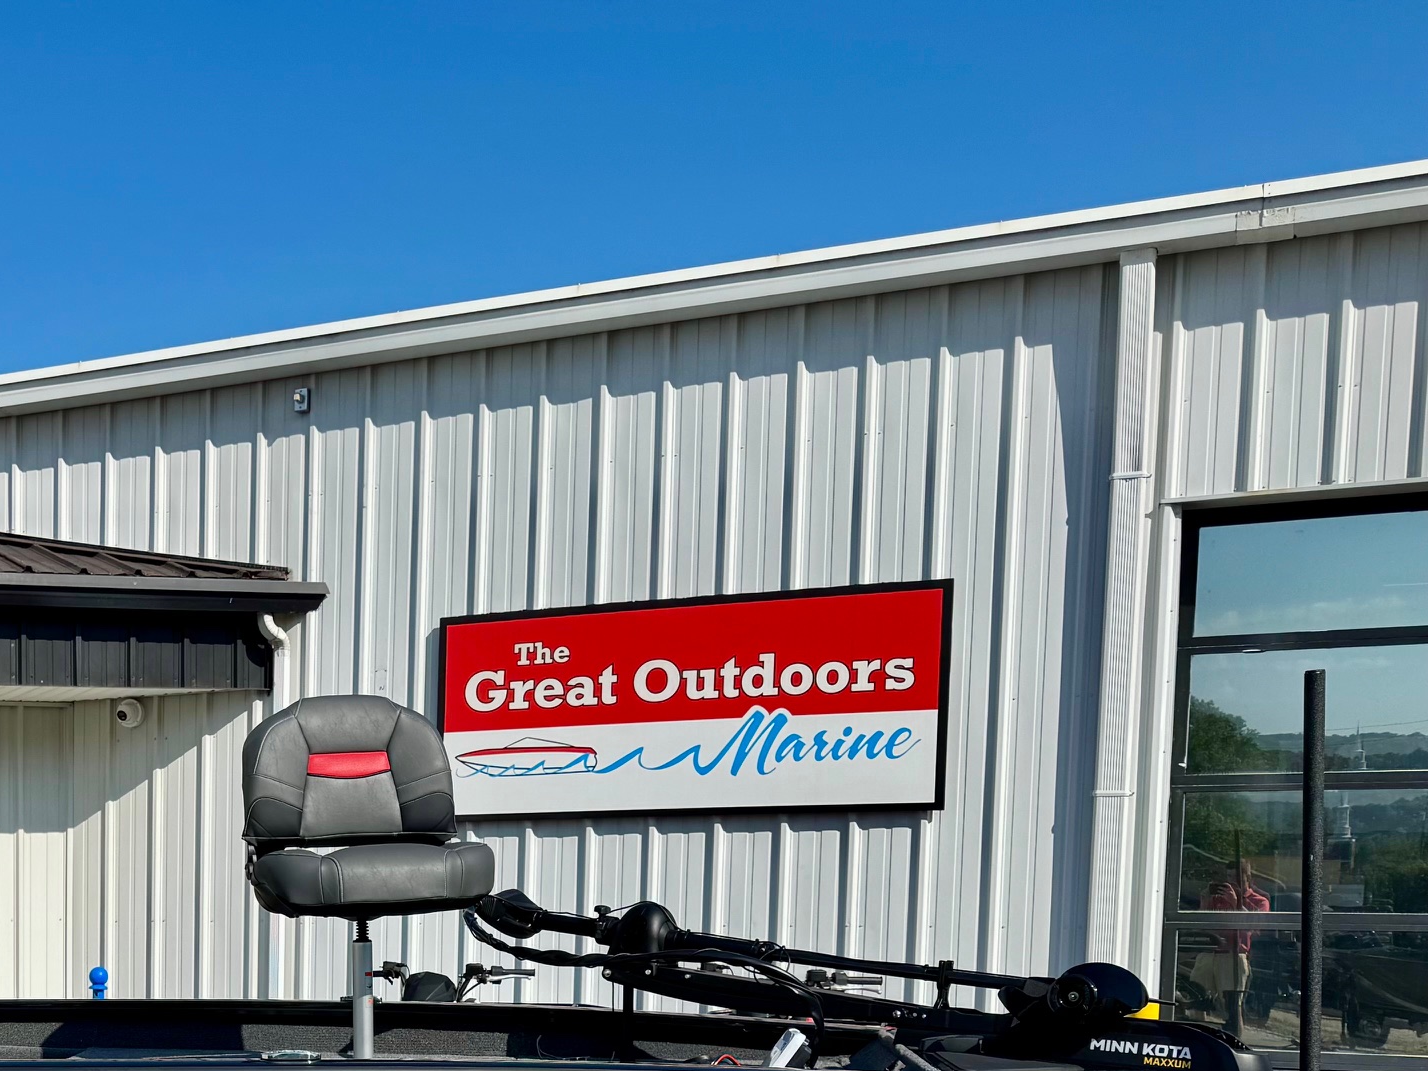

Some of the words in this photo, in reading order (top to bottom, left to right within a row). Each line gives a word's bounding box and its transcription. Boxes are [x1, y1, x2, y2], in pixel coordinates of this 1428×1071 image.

[514, 641, 570, 666] The
[464, 663, 618, 712] Great
[633, 653, 915, 702] Outdoors
[693, 710, 921, 777] Marine
[1089, 1038, 1139, 1055] MINN
[1141, 1042, 1192, 1060] KOTA
[1143, 1056, 1192, 1069] MAXXUM
